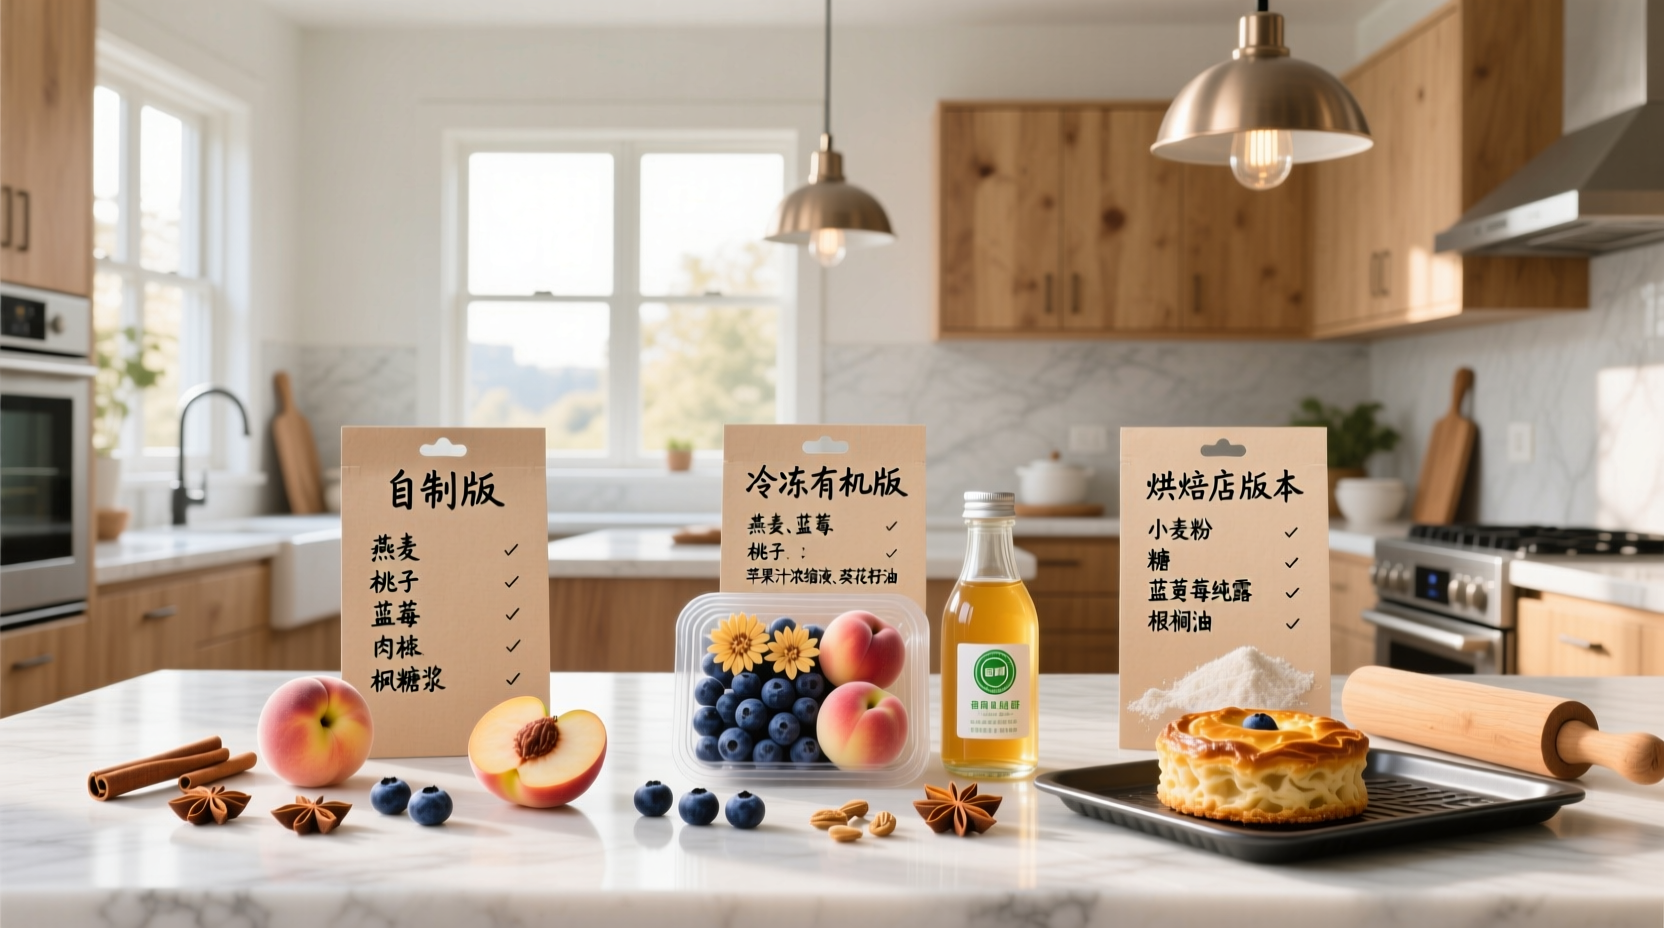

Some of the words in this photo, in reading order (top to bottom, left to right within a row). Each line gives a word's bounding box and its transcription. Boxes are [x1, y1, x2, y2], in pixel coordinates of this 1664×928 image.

[389, 468, 505, 511] 自制版
[745, 464, 909, 501] 冷冻有机版
[1146, 468, 1304, 504] 烘焙店版本
[1148, 517, 1213, 541] 小麦粉
[370, 532, 421, 563] 燕麦
[1147, 547, 1171, 572] 糖
[369, 569, 419, 594] 桃子
[370, 599, 421, 628] 蓝莓
[370, 664, 446, 693] 枫糖浆
